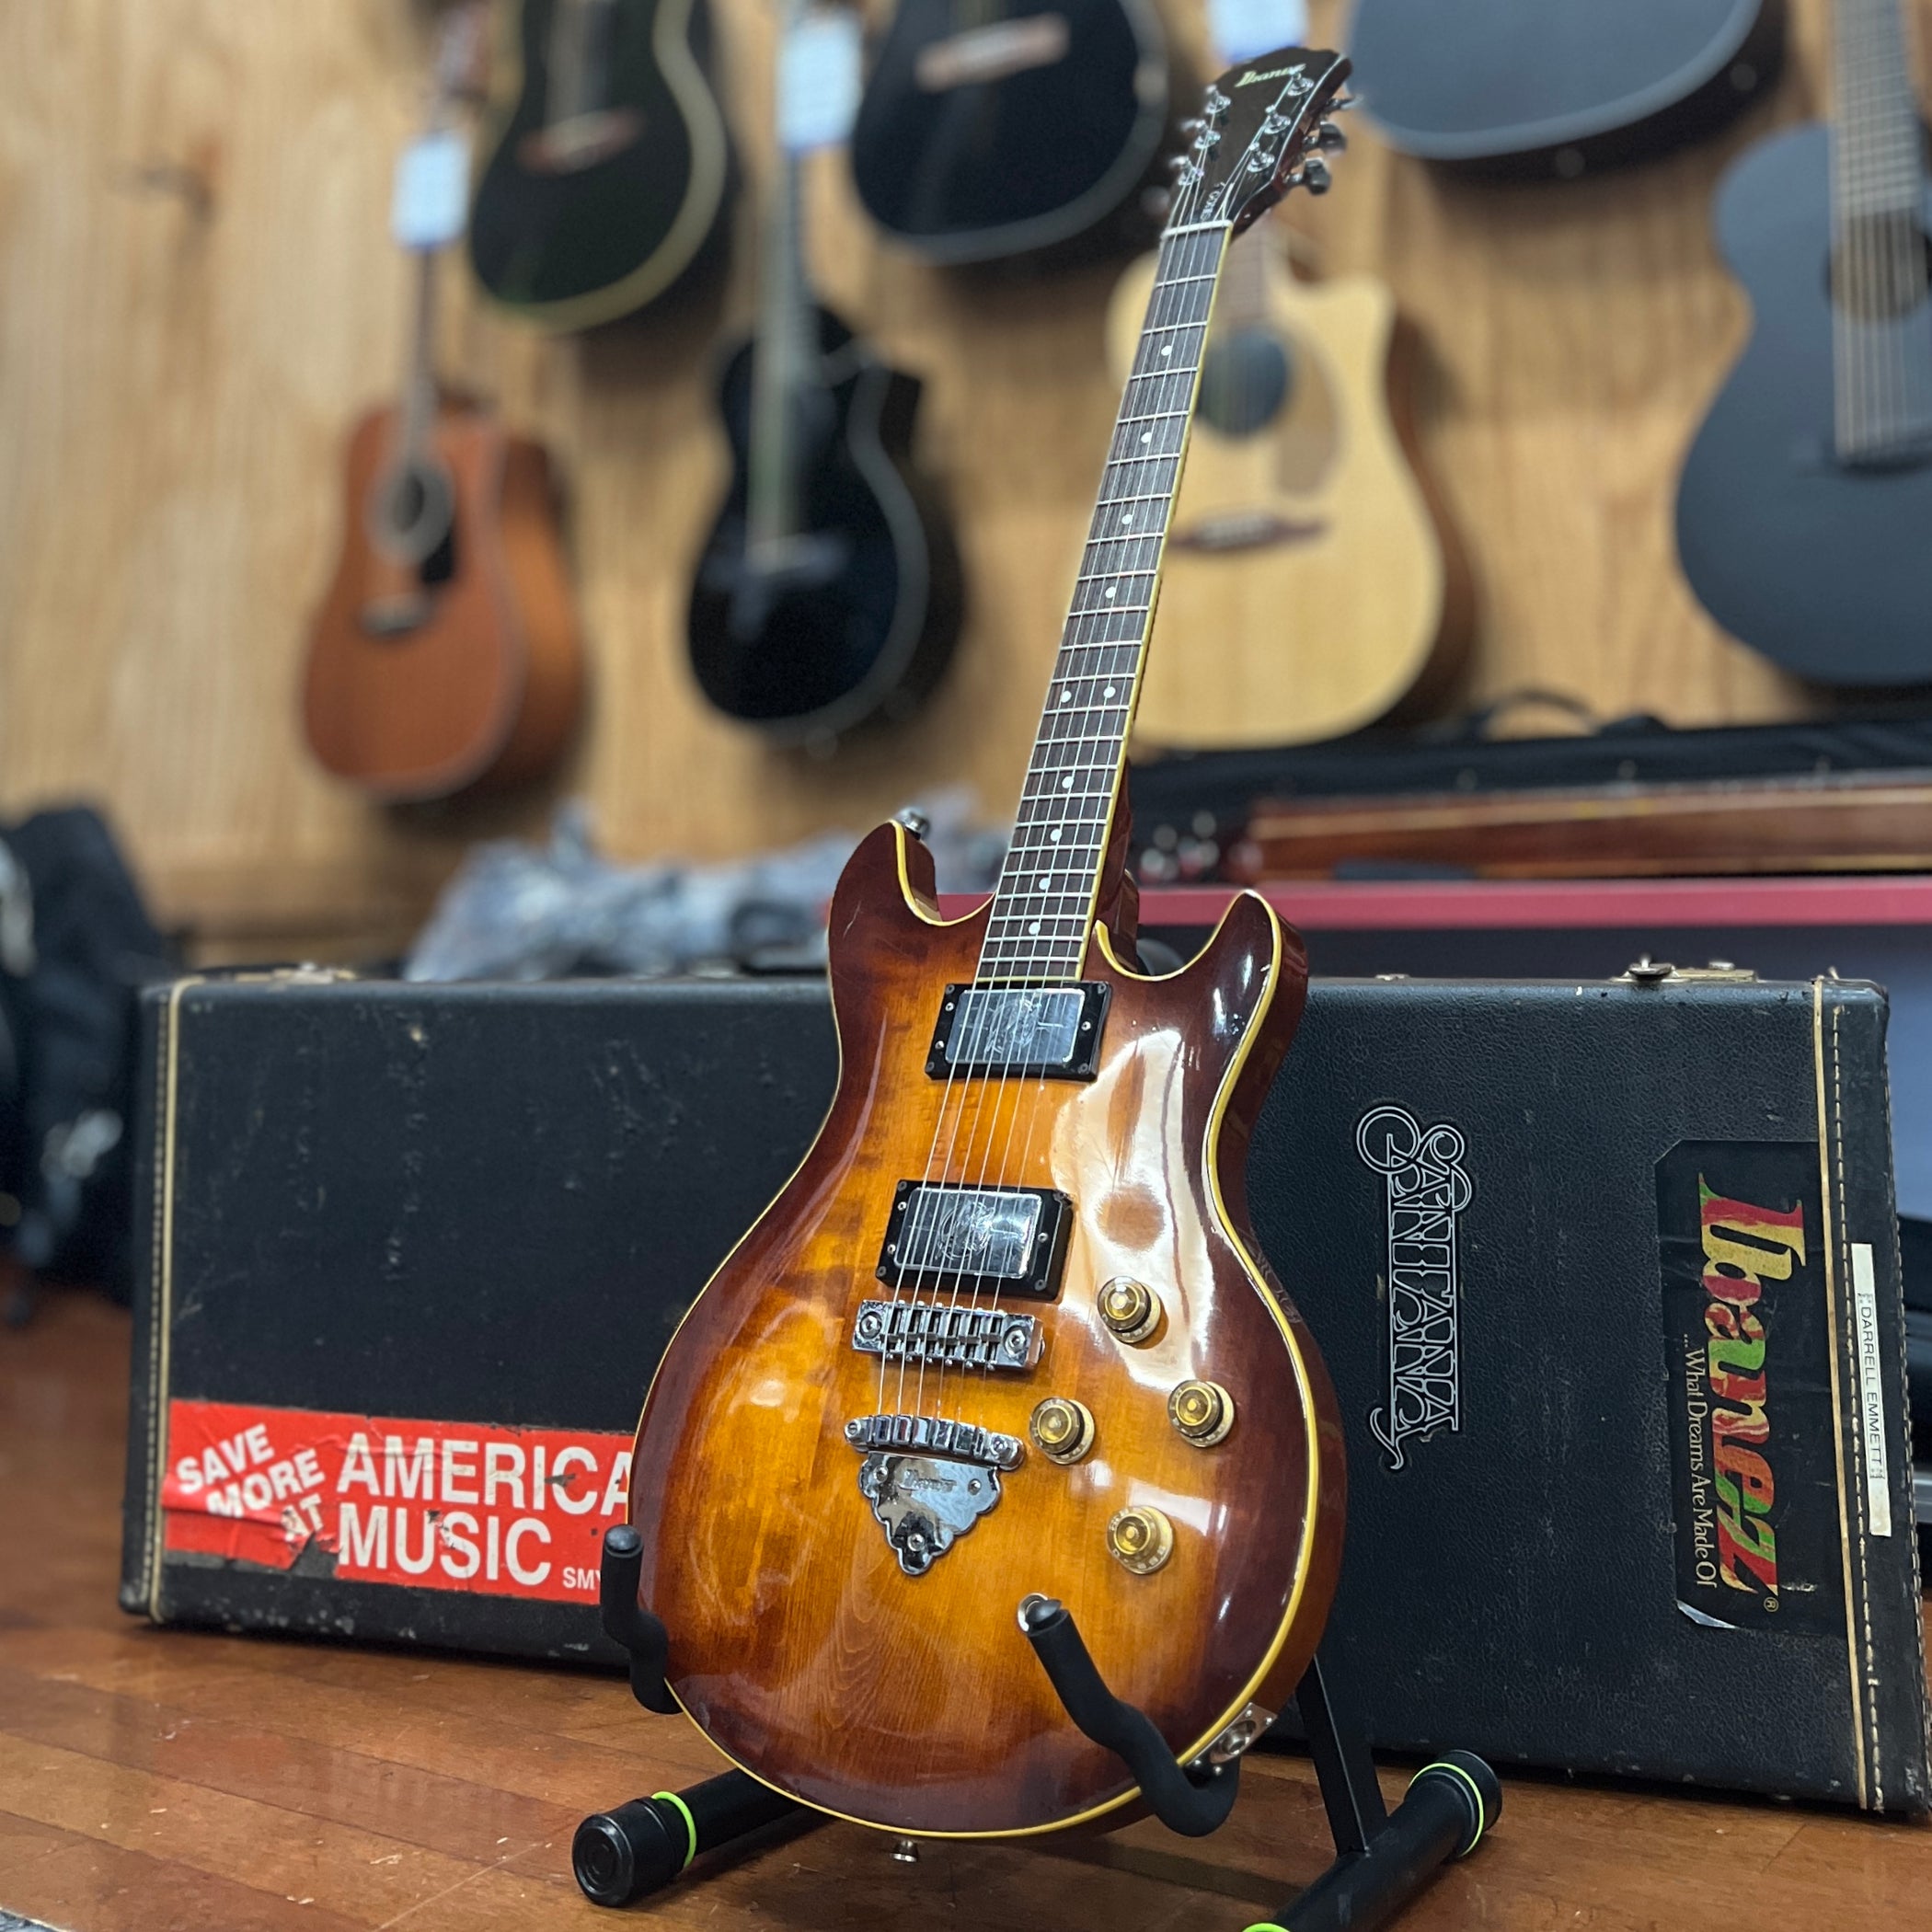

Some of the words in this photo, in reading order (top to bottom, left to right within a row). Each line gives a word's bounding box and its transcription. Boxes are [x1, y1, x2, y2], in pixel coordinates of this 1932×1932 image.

[1860, 1306, 1876, 1386] DARRELL
[1697, 1171, 1806, 1596] Ibanez
[176, 1422, 274, 1495] SAVE
[1687, 1400, 1708, 1471] Dreams
[1867, 1392, 1882, 1466] EMMETT
[206, 1448, 326, 1519] MORE
[337, 1432, 631, 1517] AMERICA
[1691, 1473, 1711, 1506] Are
[338, 1502, 552, 1586] MUSIC
[1693, 1507, 1715, 1559] Made
[1696, 1561, 1718, 1588] Of
